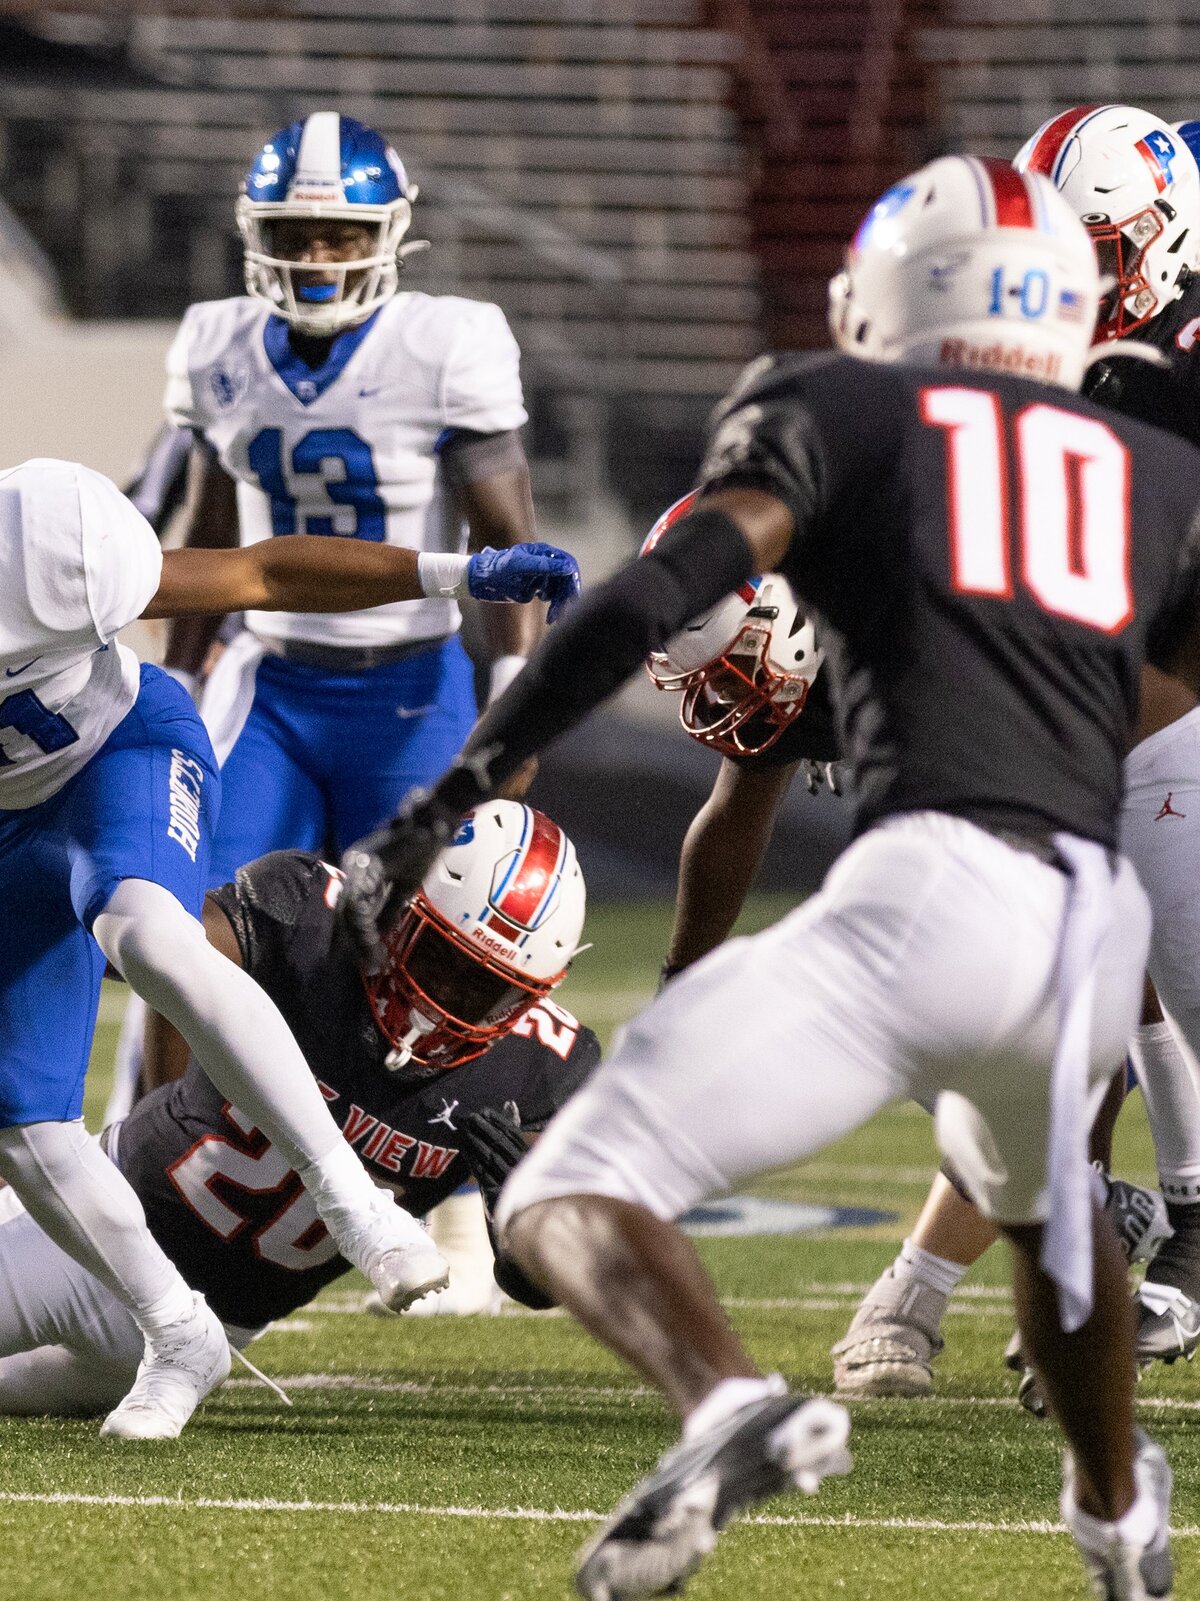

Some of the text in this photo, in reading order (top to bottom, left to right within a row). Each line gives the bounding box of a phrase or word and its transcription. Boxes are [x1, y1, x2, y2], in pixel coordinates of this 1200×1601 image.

[248, 427, 387, 543] 13
[915, 383, 1137, 637] 10
[471, 926, 518, 962] Riddell
[341, 1103, 460, 1179] VIEW
